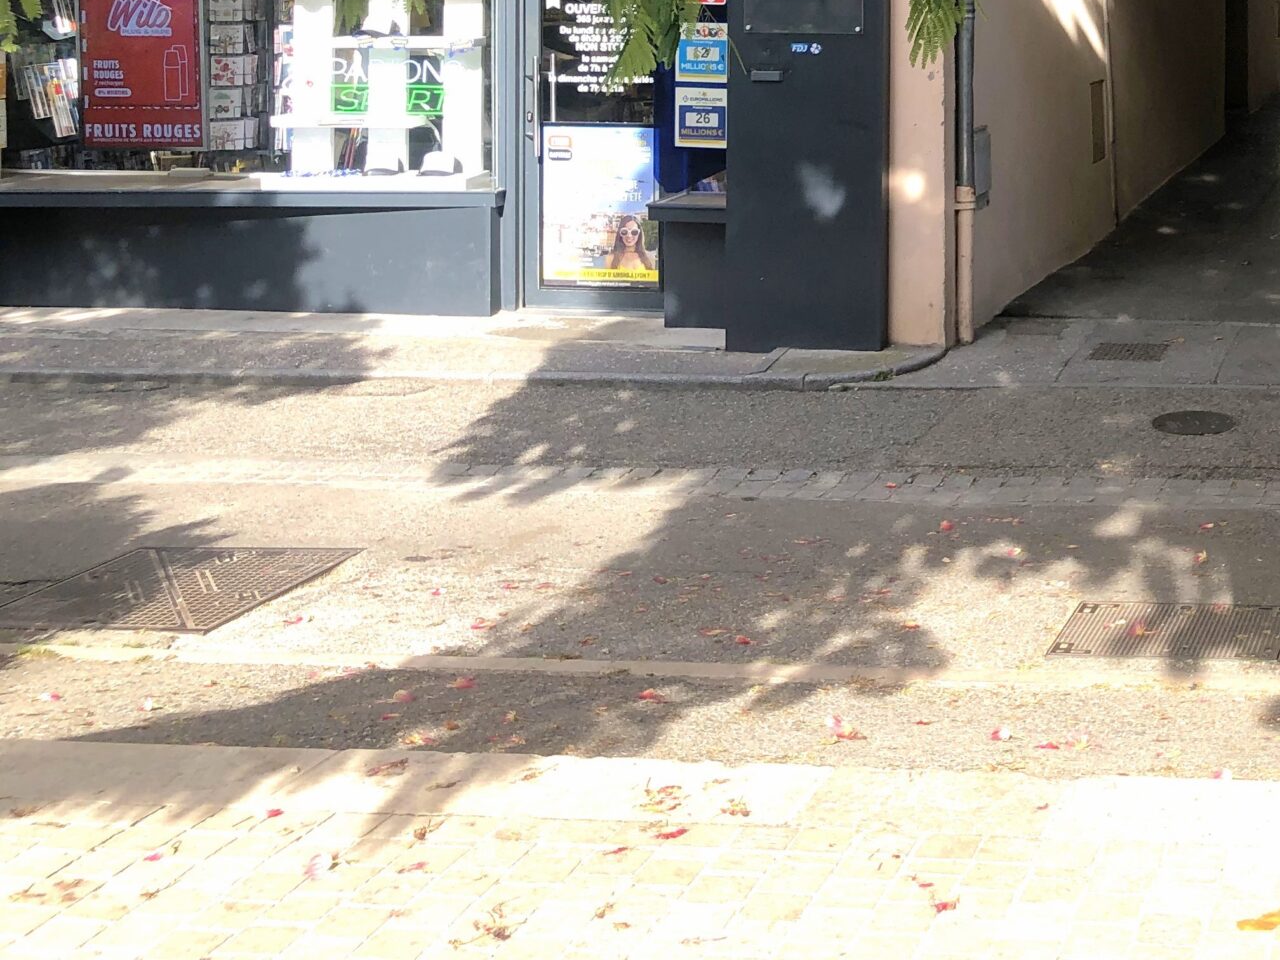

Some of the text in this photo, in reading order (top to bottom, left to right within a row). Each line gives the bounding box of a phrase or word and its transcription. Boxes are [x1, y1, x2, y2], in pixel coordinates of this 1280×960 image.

[575, 42, 598, 52] NON
[791, 43, 808, 53] FDJ
[93, 60, 120, 69] FRUITS
[93, 70, 124, 79] ROUGES
[695, 112, 711, 124] 26
[85, 123, 201, 138] FRUITS ROUGES
[680, 128, 724, 137] MILLIONS €
